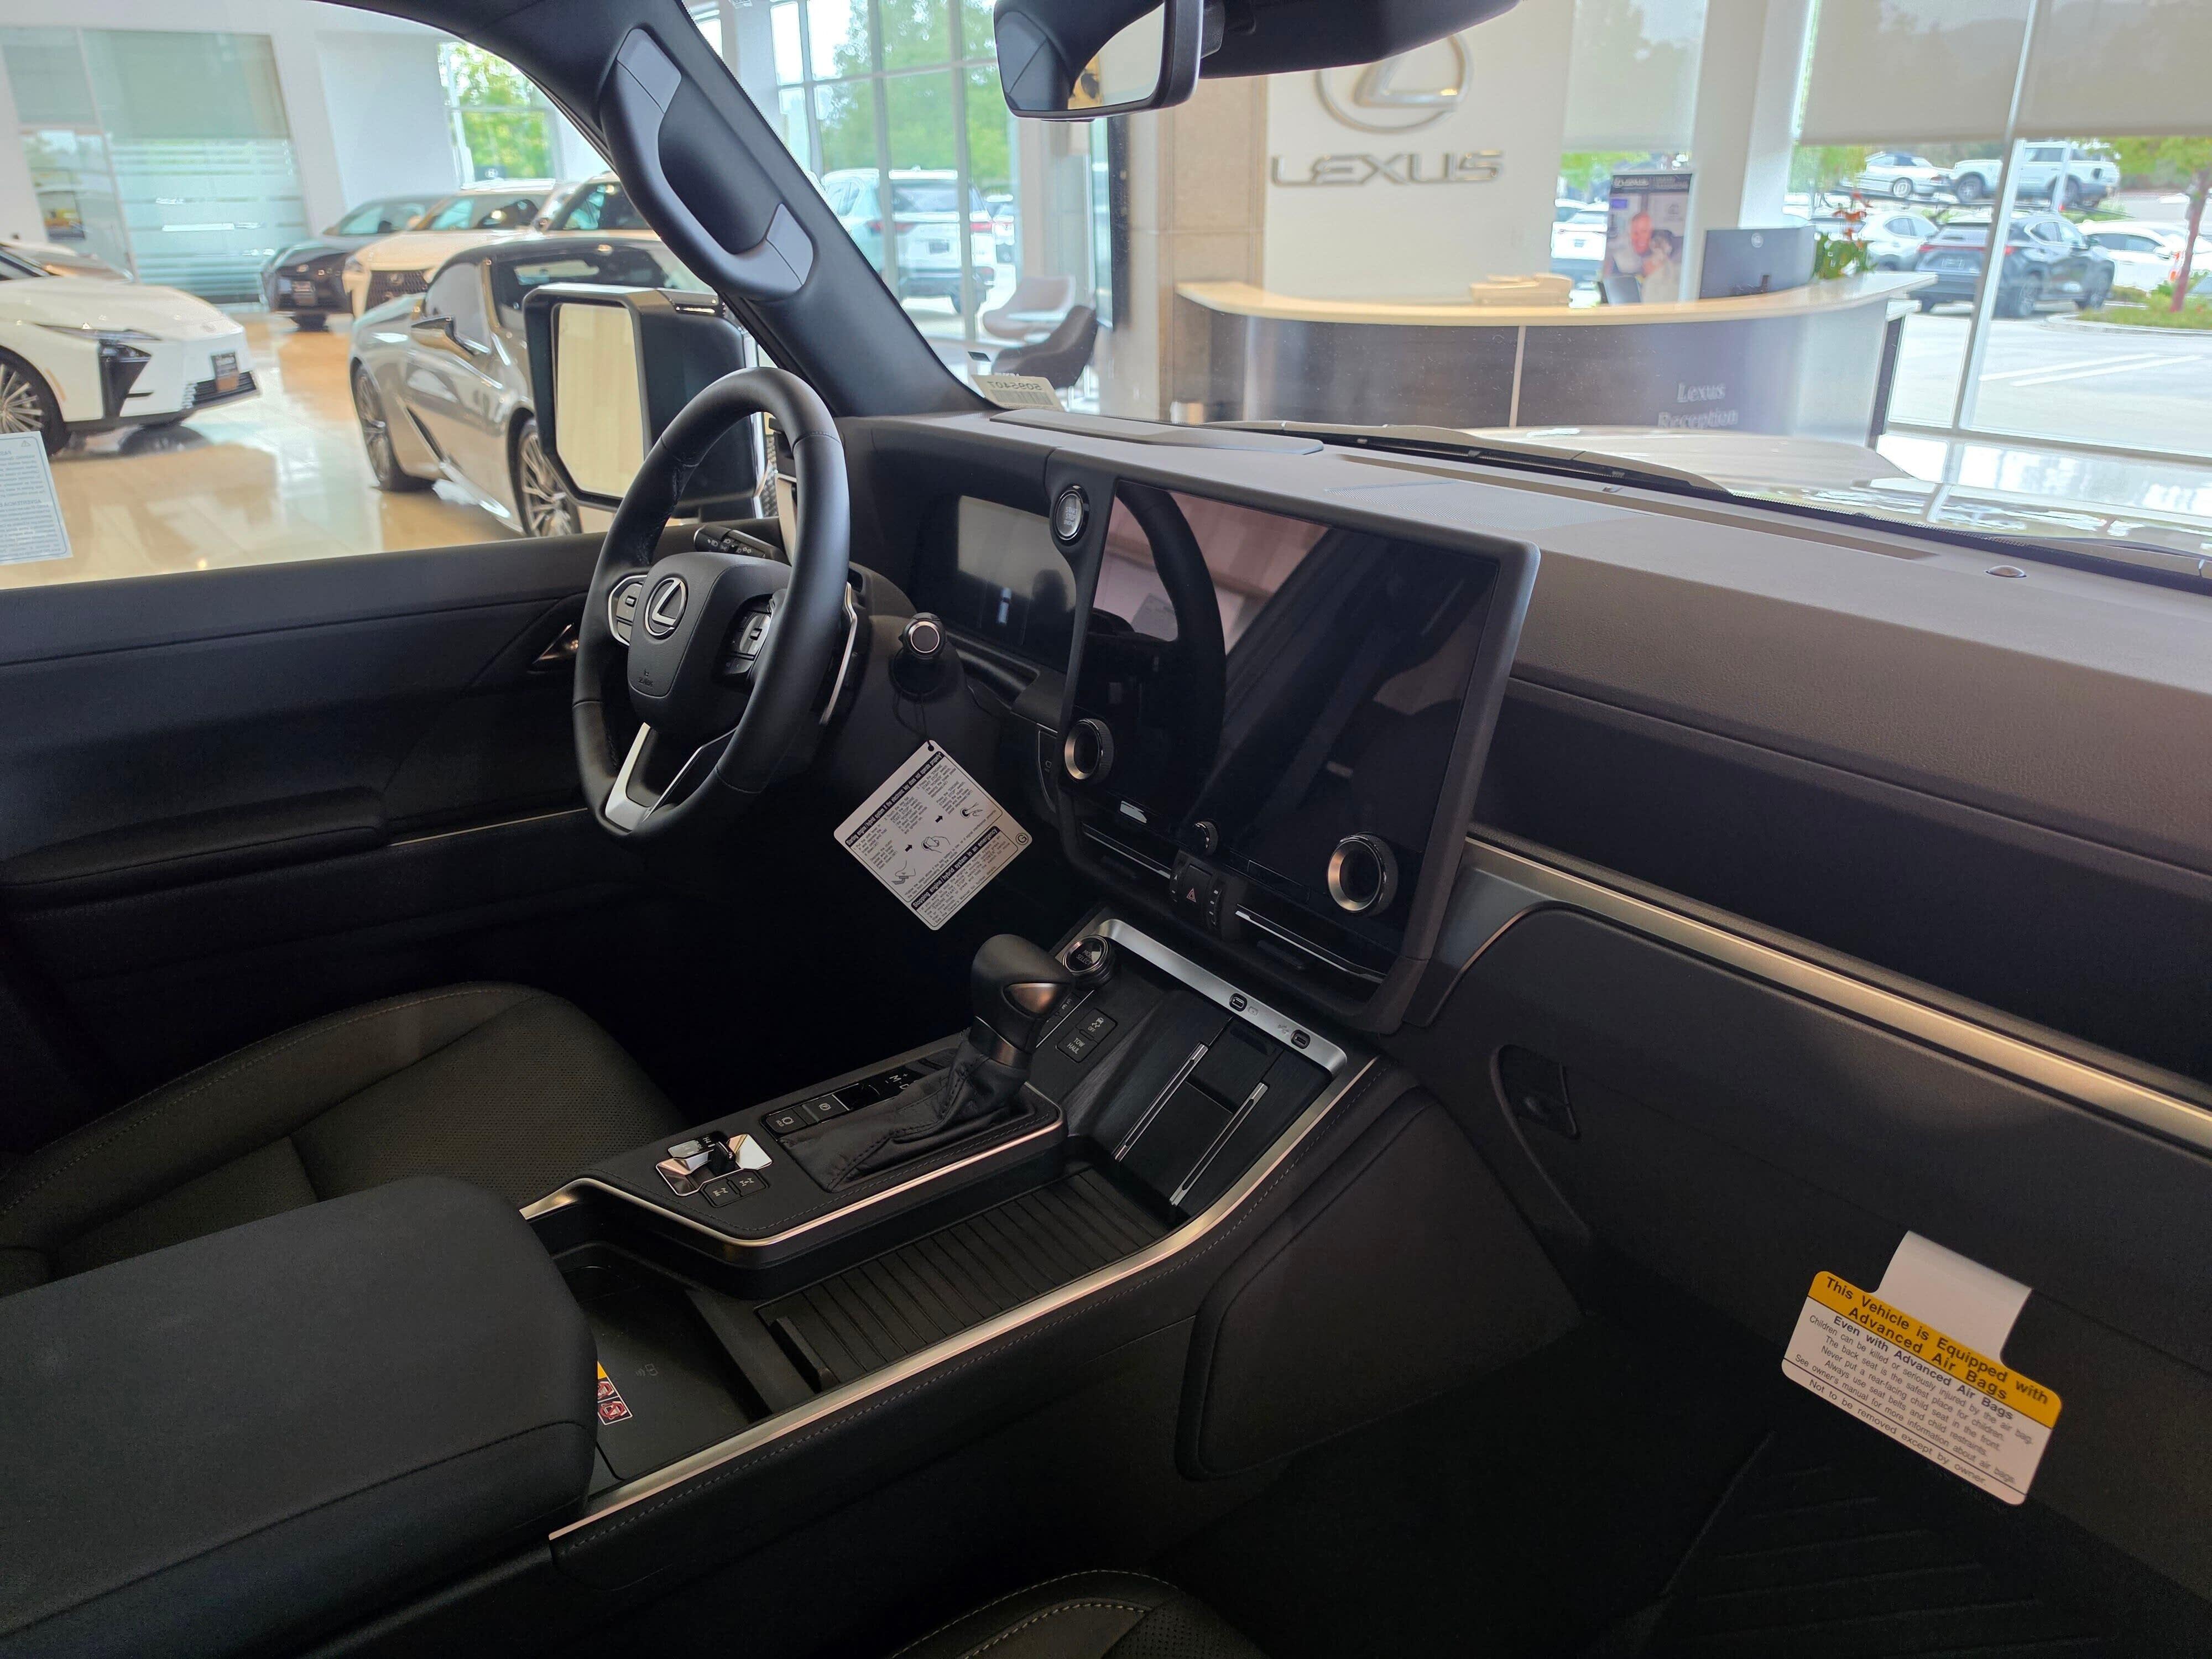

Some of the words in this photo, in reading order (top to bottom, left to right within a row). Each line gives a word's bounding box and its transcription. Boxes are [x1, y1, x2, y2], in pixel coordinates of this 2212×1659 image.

[1272, 150, 1503, 187] LEXUS
[1677, 383, 1726, 403] Lexus
[913, 892, 930, 907] Stopping
[954, 855, 967, 868] system
[978, 828, 997, 846] emergency
[1018, 834, 1027, 844] G
[1067, 1042, 1079, 1054] HAUL
[1073, 1037, 1086, 1047] TOW
[1809, 1314, 1838, 1336] Children
[1840, 1333, 1854, 1345] can
[1856, 1340, 1866, 1352] be
[1869, 1348, 1889, 1364] killed
[1902, 1368, 1936, 1391] seriously
[1938, 1386, 1966, 1407] injured
[1969, 1403, 1980, 1415] by
[1983, 1411, 1996, 1423] the
[1999, 1422, 2012, 1431] air
[1825, 1334, 1839, 1348] The
[1841, 1344, 1859, 1360] back
[1861, 1358, 1878, 1370] seat
[1880, 1366, 1887, 1376] is
[1890, 1373, 1902, 1384] the
[1905, 1382, 1929, 1399] safest
[1931, 1397, 1953, 1412] place
[1956, 1408, 1969, 1420] for
[1827, 1275, 1854, 1300] This
[1861, 1295, 1910, 1330] Vehicle
[1916, 1325, 1929, 1340] is
[1936, 1336, 2008, 1383] Equipped
[2016, 1380, 2048, 1404] with
[1833, 1314, 1860, 1337] Even
[1865, 1334, 1888, 1352] with
[1893, 1349, 1952, 1386] Advanced
[1955, 1384, 1976, 1399] Air
[1980, 1396, 2013, 1420] Bags
[1848, 1307, 1923, 1354] Advanced
[1931, 1352, 1956, 1371] Air
[1964, 1369, 2007, 1399] Bags
[1794, 1353, 1809, 1367] See
[1811, 1365, 1839, 1384] owner's
[1841, 1381, 1869, 1401] manual
[1871, 1397, 1882, 1408] for
[1884, 1406, 1904, 1421] more
[1906, 1417, 1949, 1447] information
[1952, 1445, 1976, 1462] about
[1979, 1460, 1991, 1469] air
[1808, 1378, 1825, 1394] Not
[1828, 1390, 1837, 1400] to
[1840, 1397, 1853, 1409] be
[1857, 1408, 1897, 1434] removed
[1901, 1433, 1933, 1455] except
[1937, 1452, 1950, 1464] by
[1820, 1344, 1843, 1362] Never
[1843, 1360, 1858, 1371] put
[1867, 1373, 1907, 1401] rear-facing
[1910, 1397, 1929, 1411] child
[1931, 1408, 1949, 1422] seat
[1952, 1420, 1960, 1428] in
[1963, 1425, 1976, 1437] the
[1824, 1359, 1850, 1379] Always
[1852, 1376, 1866, 1388] use
[1869, 1386, 1886, 1399] seat
[1887, 1395, 1906, 1411] belts
[1909, 1408, 1925, 1421] and
[1927, 1418, 1947, 1433] child
